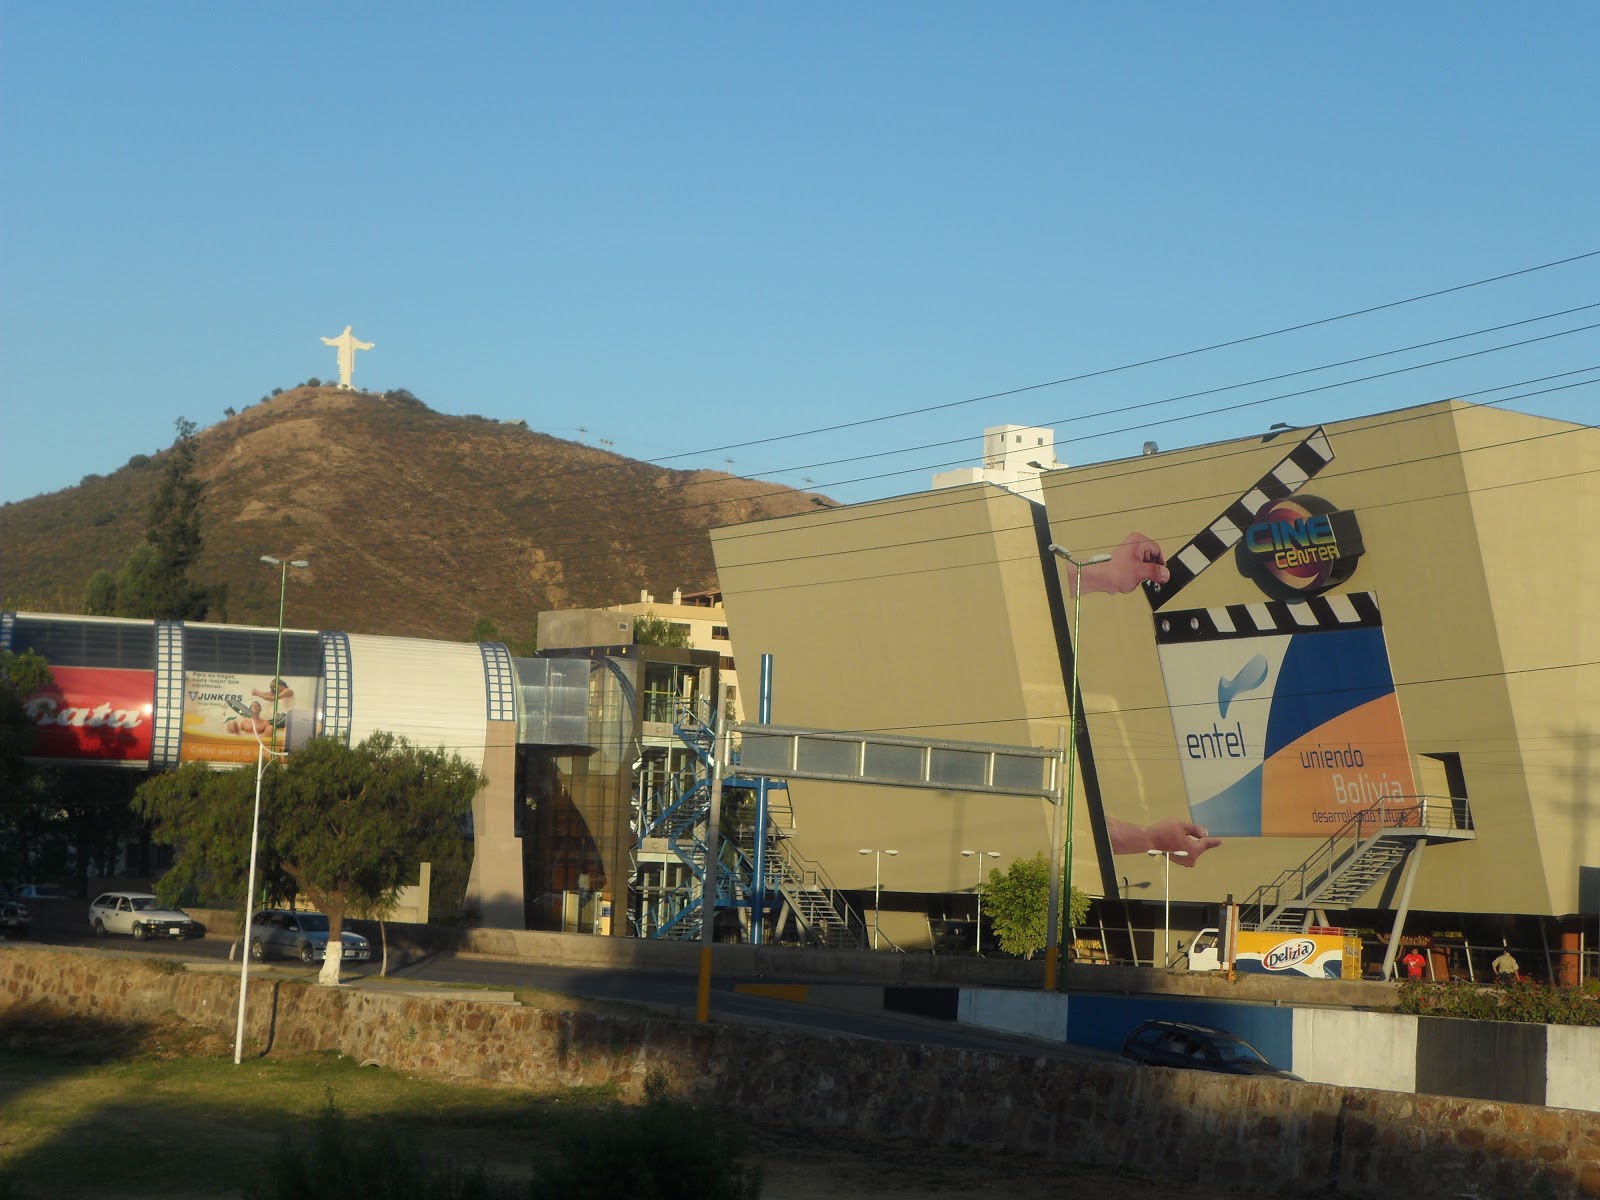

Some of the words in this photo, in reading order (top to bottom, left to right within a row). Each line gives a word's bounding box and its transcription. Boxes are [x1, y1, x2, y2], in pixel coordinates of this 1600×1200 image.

[1246, 514, 1336, 553] CINE
[197, 693, 243, 702] JUNKERS
[23, 698, 142, 728] Bata
[1186, 721, 1247, 759] entel
[1300, 743, 1364, 769] uniendo
[1332, 773, 1405, 805] Bolivia
[1269, 942, 1309, 967] Delizia
